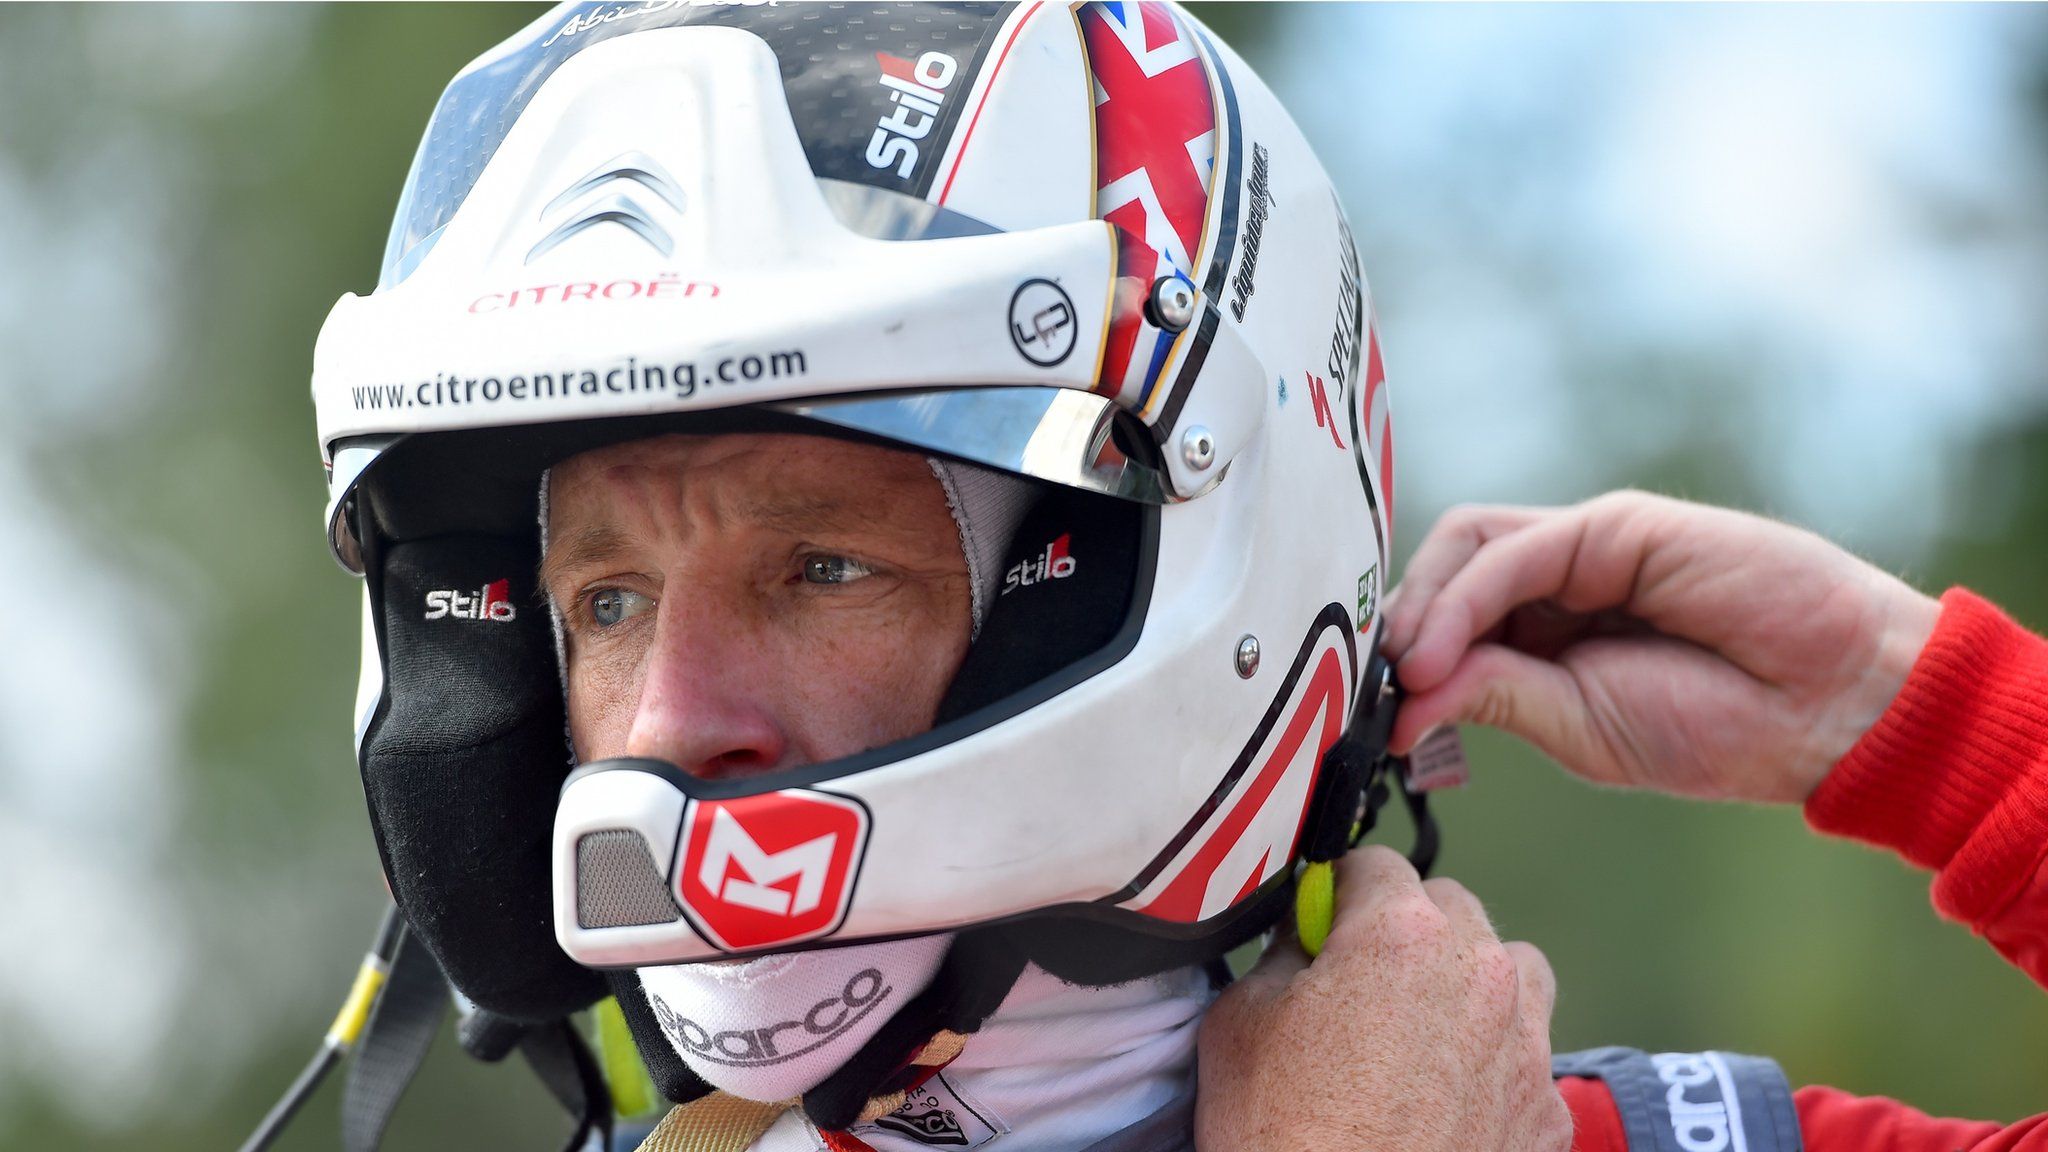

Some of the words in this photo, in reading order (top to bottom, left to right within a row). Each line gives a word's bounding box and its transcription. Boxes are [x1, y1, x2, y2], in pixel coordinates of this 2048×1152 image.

[865, 51, 958, 180] Stilo
[351, 347, 808, 410] www.citroenracing.com
[1001, 542, 1077, 596] Stilo
[425, 583, 516, 622] Stilo
